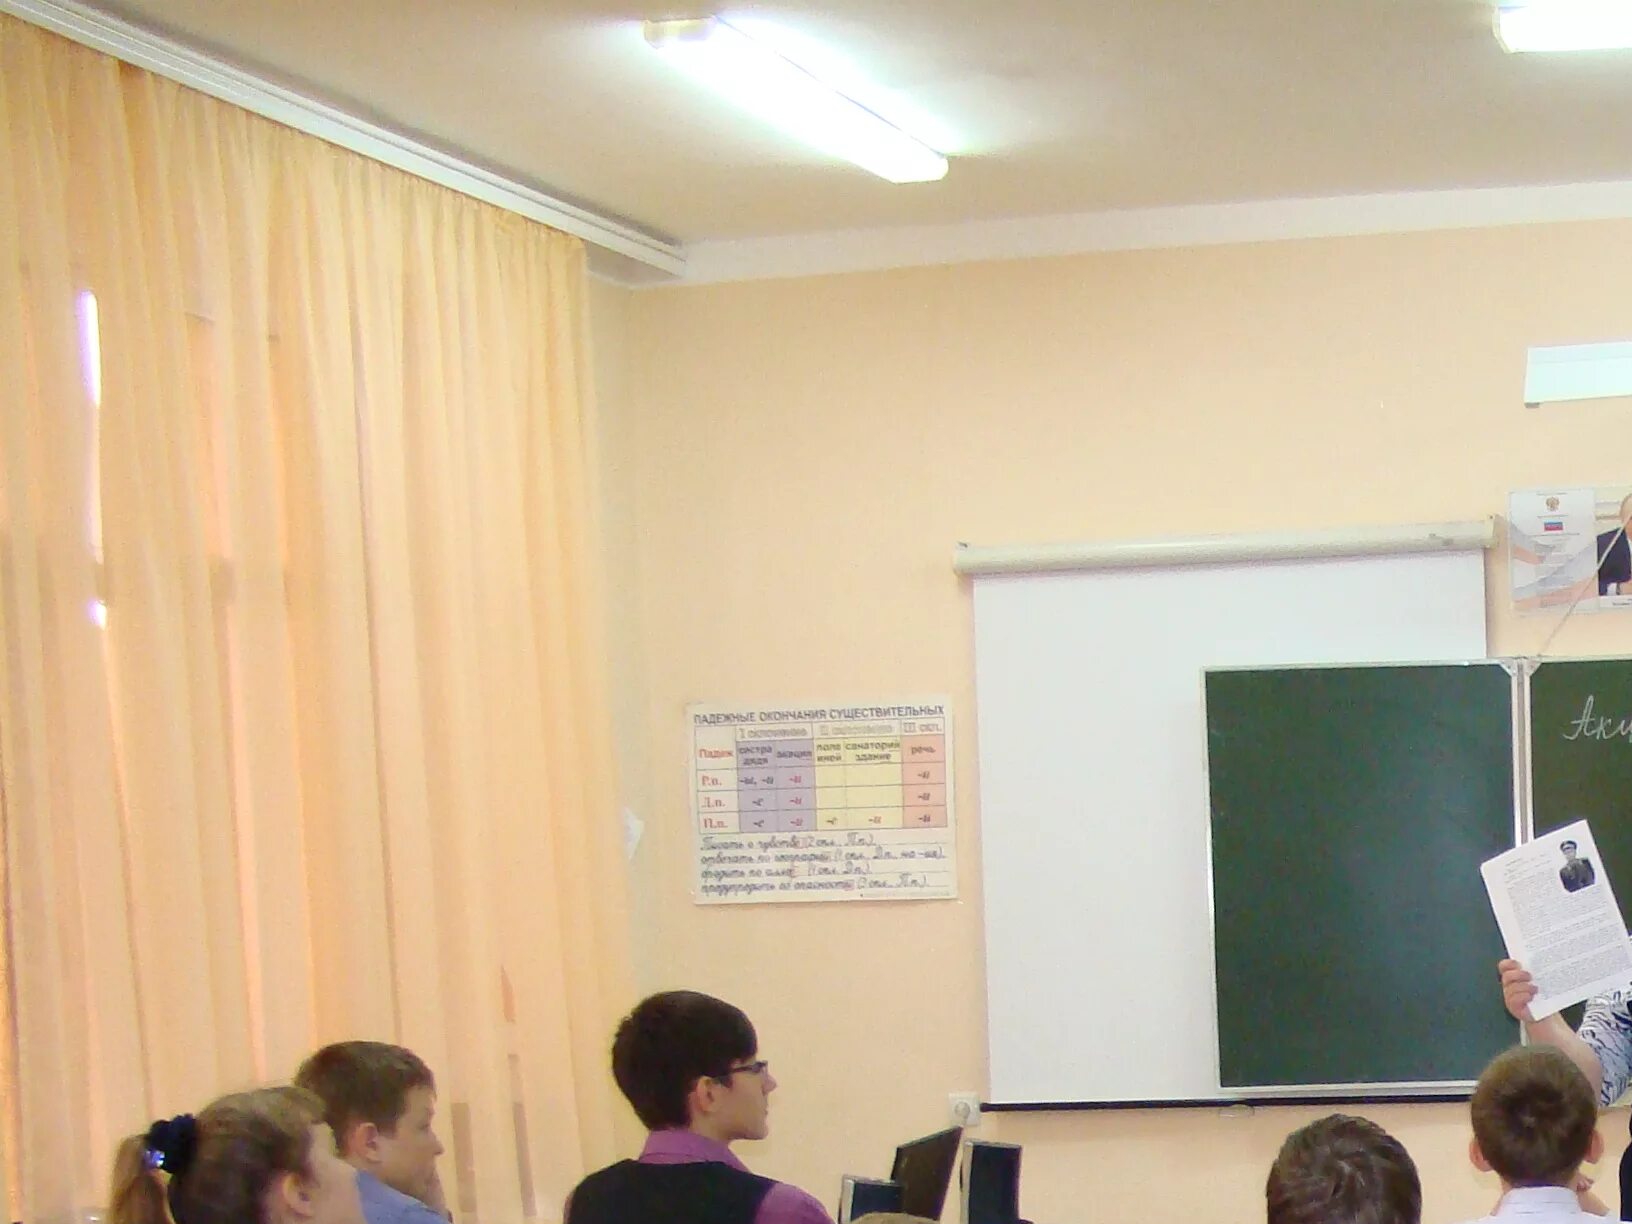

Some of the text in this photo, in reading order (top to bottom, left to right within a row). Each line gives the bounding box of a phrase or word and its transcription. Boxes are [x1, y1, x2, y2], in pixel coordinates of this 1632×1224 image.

[694, 704, 945, 724] ПАДЕЖНЫЕ ОКОНЧАНИЯ СУЩЕСТВИТЕЛЬНЫХ
